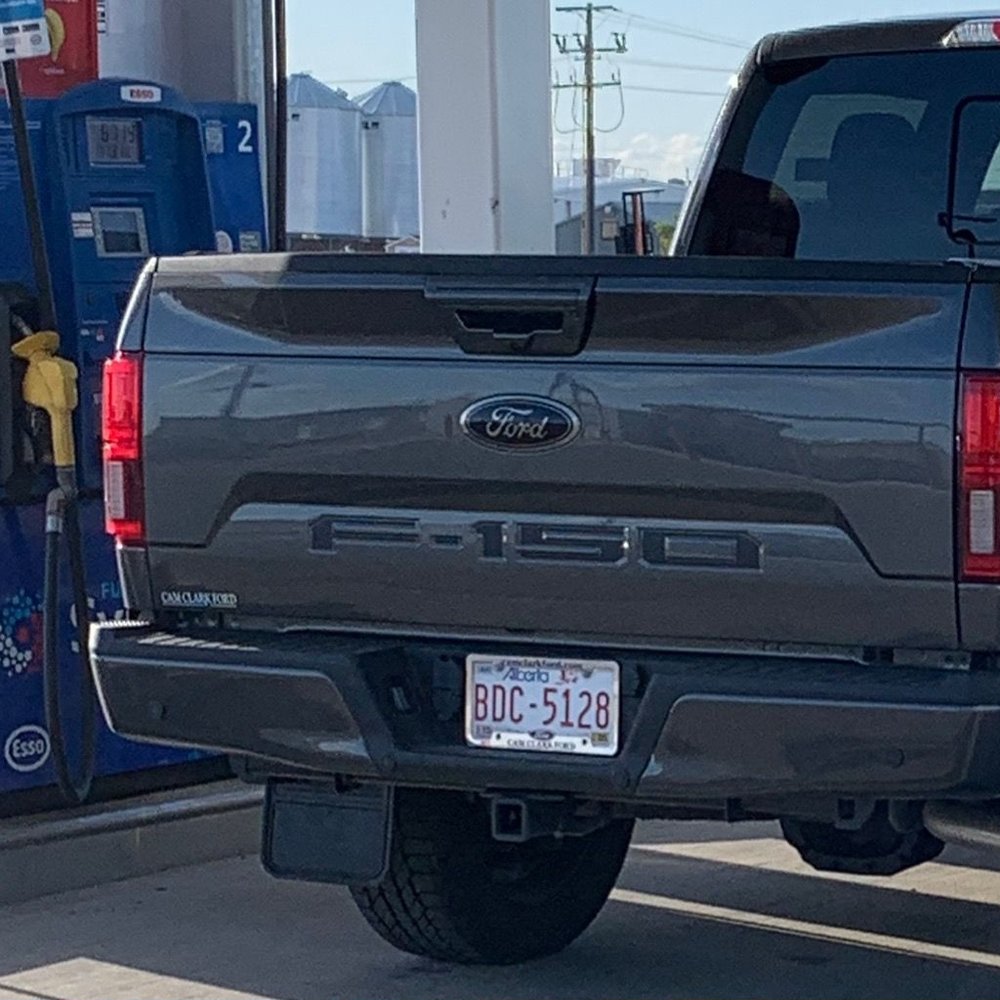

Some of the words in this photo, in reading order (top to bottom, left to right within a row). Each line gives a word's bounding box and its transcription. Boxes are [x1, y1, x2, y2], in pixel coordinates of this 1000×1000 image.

[237, 120, 253, 152] 2
[486, 406, 549, 439] Ford
[308, 513, 765, 573] F-150
[101, 581, 121, 599] FU
[502, 667, 550, 683] Alberta
[474, 684, 610, 729] BDC-5128
